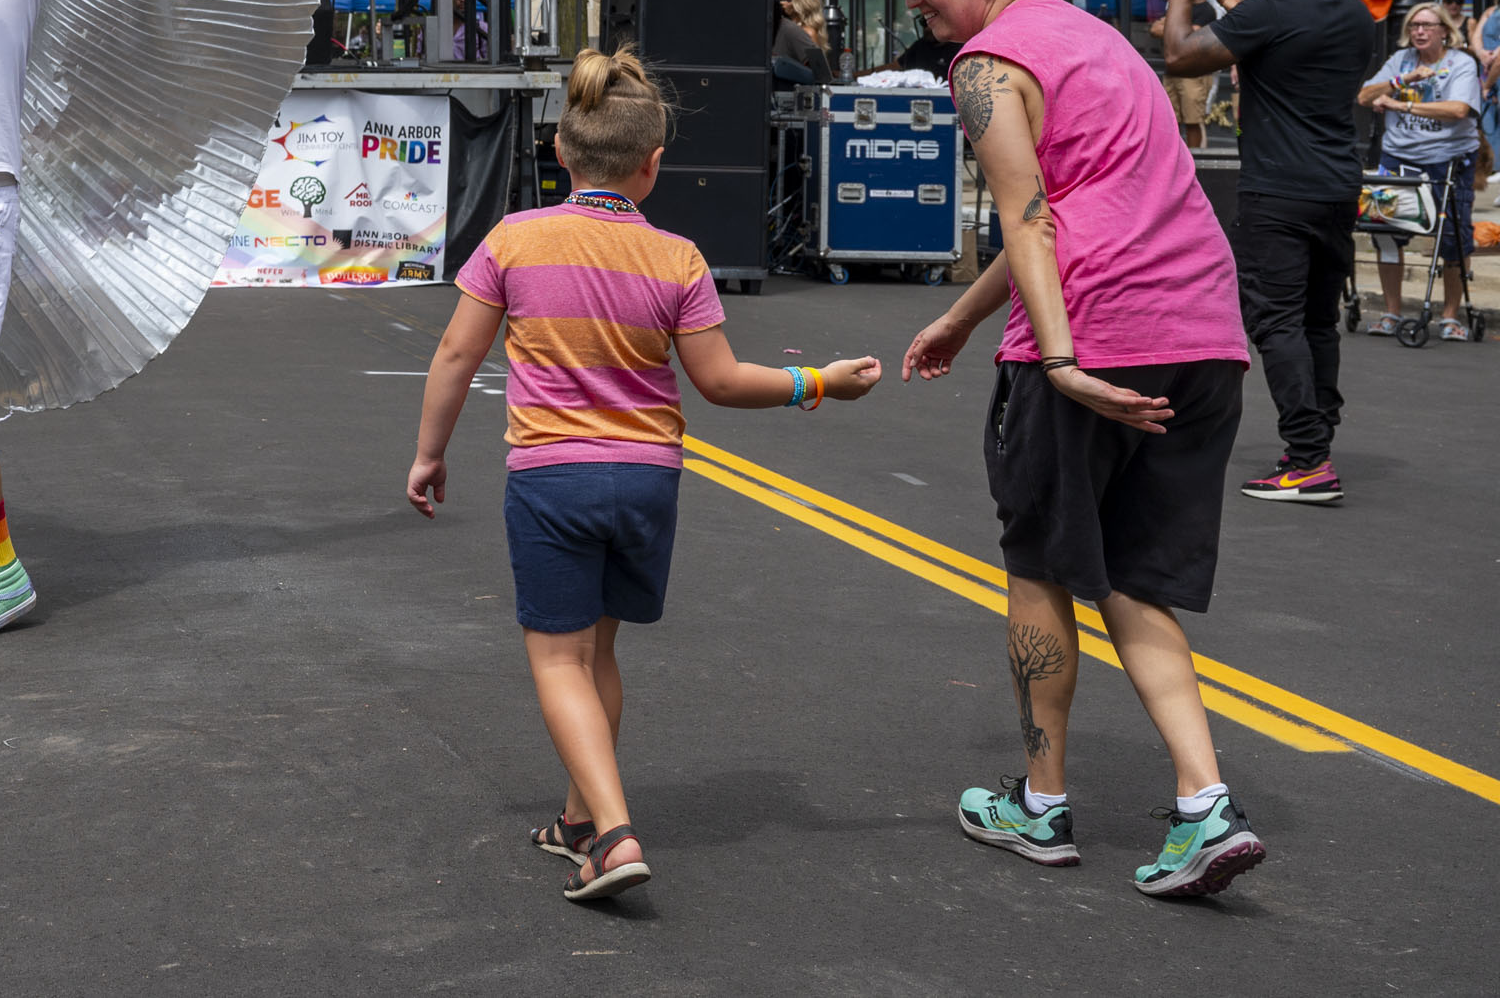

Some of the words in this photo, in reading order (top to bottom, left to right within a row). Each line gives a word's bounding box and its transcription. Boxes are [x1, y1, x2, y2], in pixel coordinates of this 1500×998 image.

[363, 120, 394, 137] ANN
[398, 126, 442, 139] ARBOR
[296, 132, 317, 144] JIM
[320, 131, 344, 143] TOY
[362, 134, 442, 164] PRIDE
[845, 139, 940, 160] MIDAS
[382, 200, 438, 214] COMCAST
[254, 235, 327, 248] NECTO
[356, 230, 378, 239] ANN
[395, 241, 441, 255] LIBRARY
